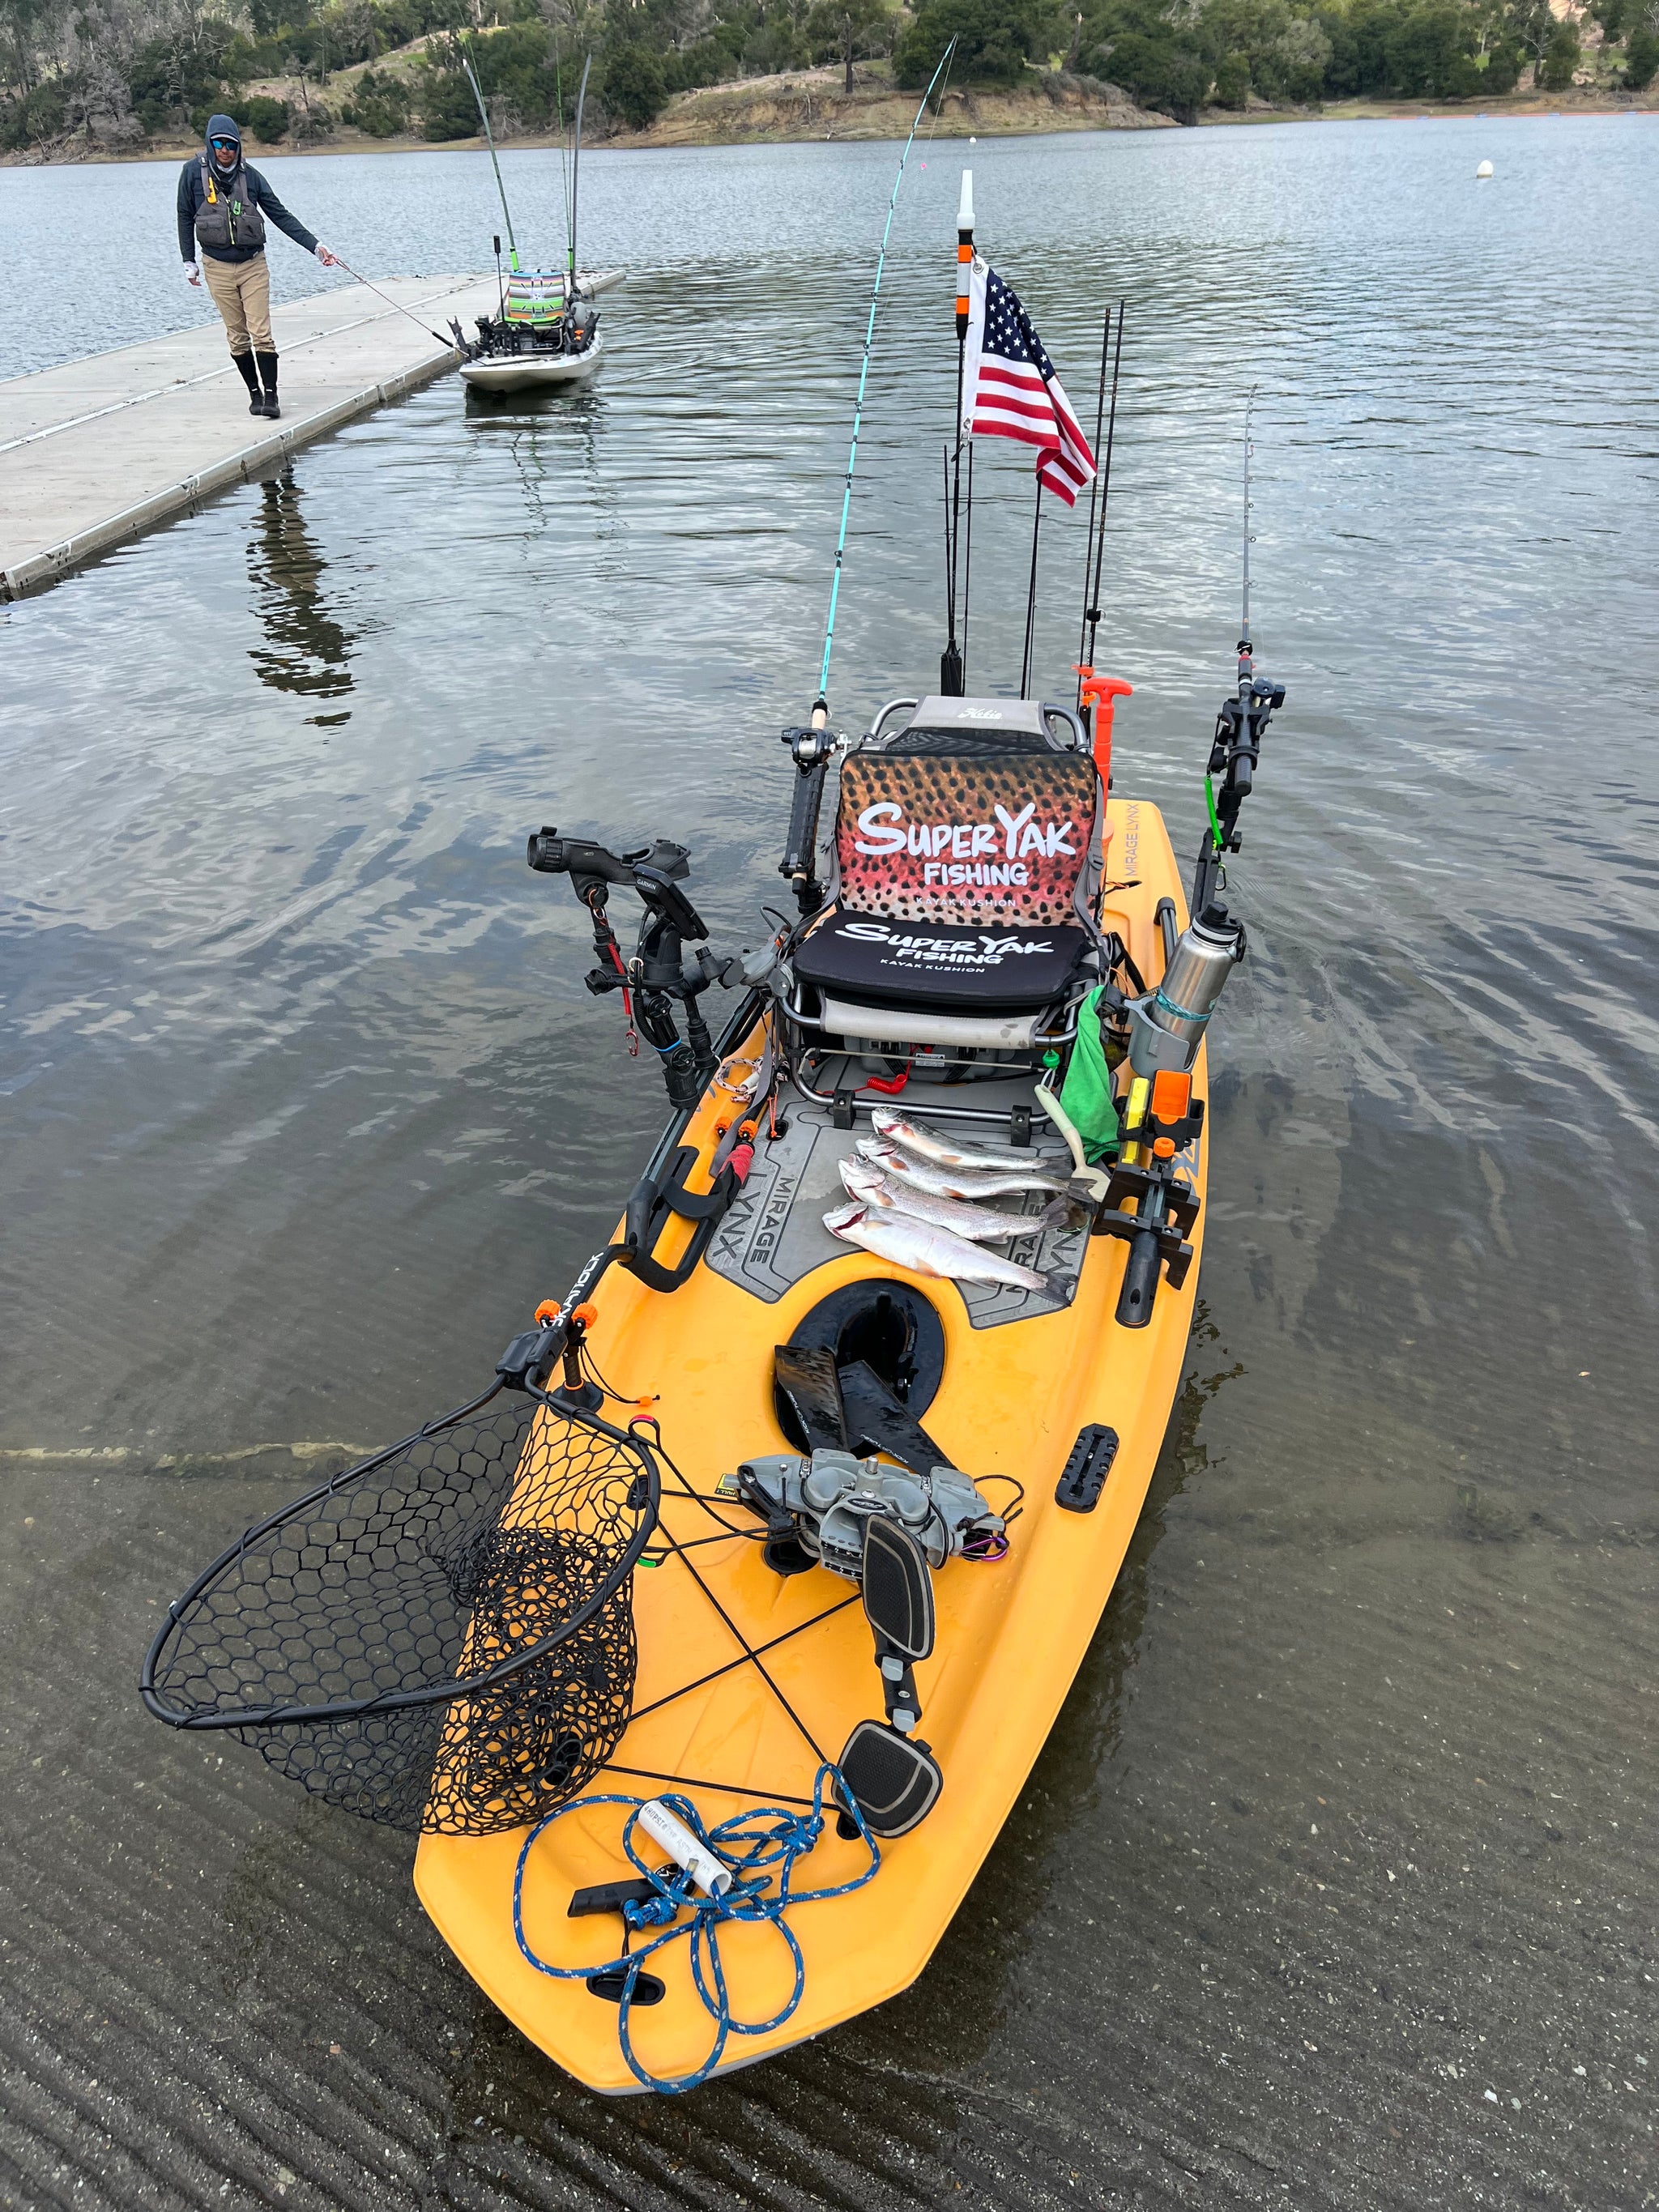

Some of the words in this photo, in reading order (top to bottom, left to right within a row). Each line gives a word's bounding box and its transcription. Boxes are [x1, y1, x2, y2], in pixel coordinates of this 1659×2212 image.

[957, 707, 1004, 720] Hobie
[1126, 803, 1140, 830] LYNX
[1124, 833, 1138, 876] MIRAGE
[637, 879, 656, 890] GARMIN
[924, 862, 1029, 887] FISHING
[915, 897, 957, 906] KAYAK
[959, 898, 1017, 907] KUSHION
[880, 958, 922, 970] KAYAK
[925, 964, 985, 974] KUSHION
[895, 948, 1004, 965] FISHING
[713, 1172, 768, 1259] LYNX
[750, 1177, 795, 1264] MIRAGE
